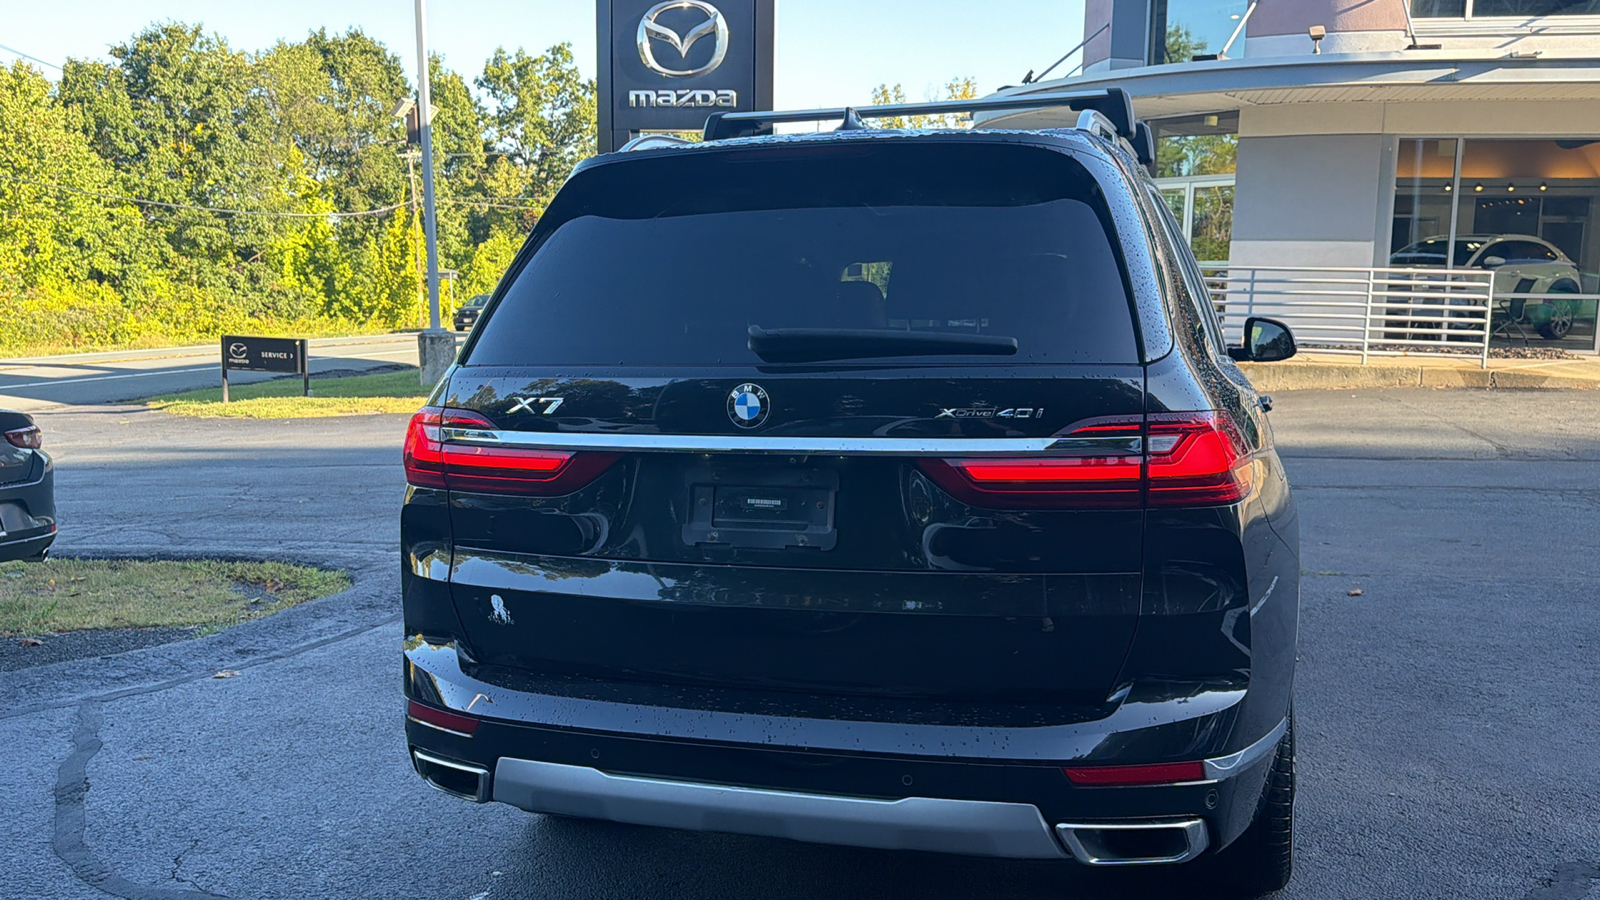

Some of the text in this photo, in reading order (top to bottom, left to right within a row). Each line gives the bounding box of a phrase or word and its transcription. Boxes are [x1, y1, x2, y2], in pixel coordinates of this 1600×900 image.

[261, 351, 287, 359] SERVICE
[731, 385, 765, 399] BMW
[505, 396, 564, 415] X7
